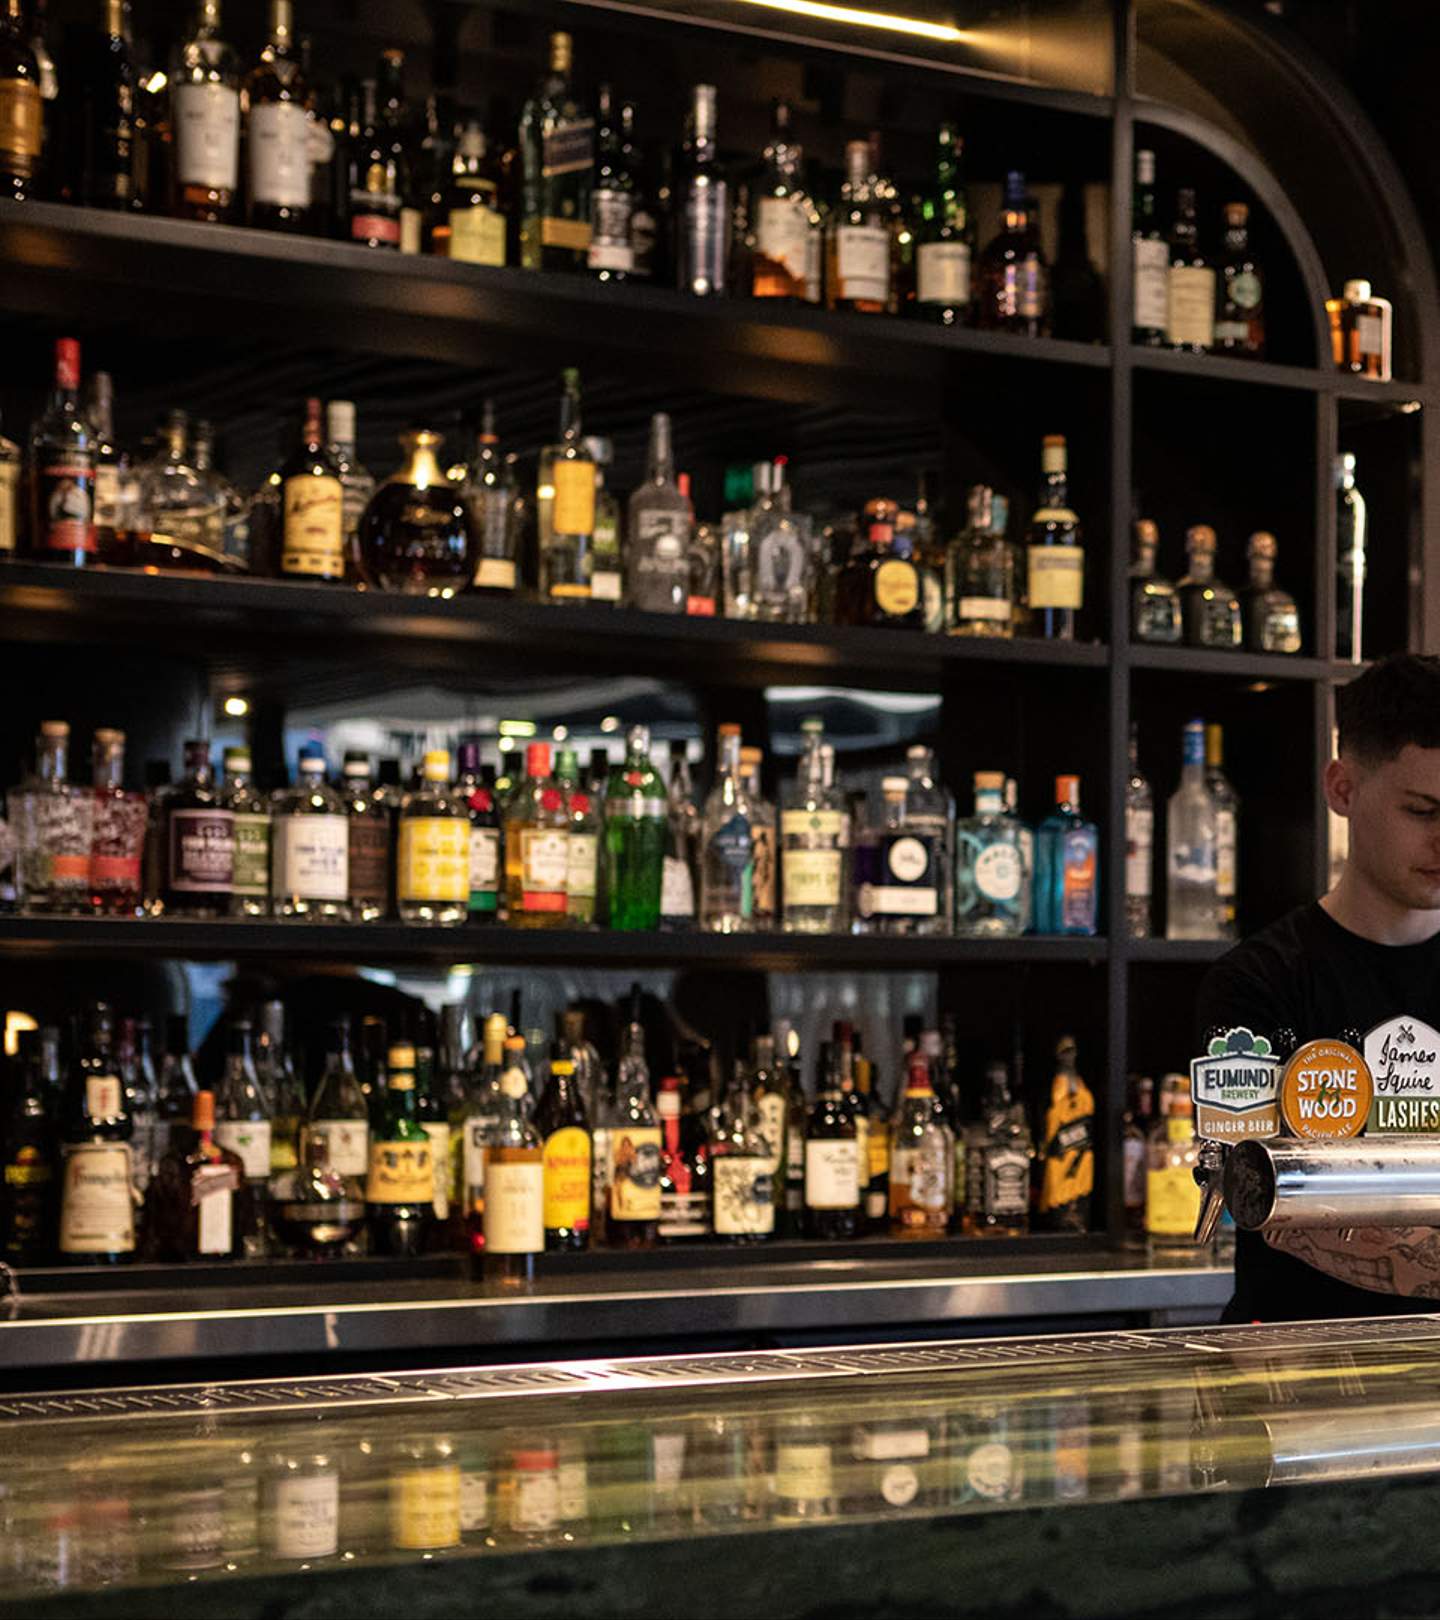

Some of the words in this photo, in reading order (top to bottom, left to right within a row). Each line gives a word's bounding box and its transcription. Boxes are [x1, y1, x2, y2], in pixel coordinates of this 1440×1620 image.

[1379, 1033, 1437, 1066] James
[1204, 1068, 1275, 1091] EUMUNDI
[1297, 1068, 1358, 1092] STONE
[1376, 1062, 1434, 1094] Squire
[1221, 1089, 1260, 1099] BREWERY
[1297, 1096, 1357, 1119] WOOD
[1378, 1100, 1440, 1129] LASHES
[1204, 1120, 1246, 1133] GINGER
[1248, 1119, 1274, 1133] BEER
